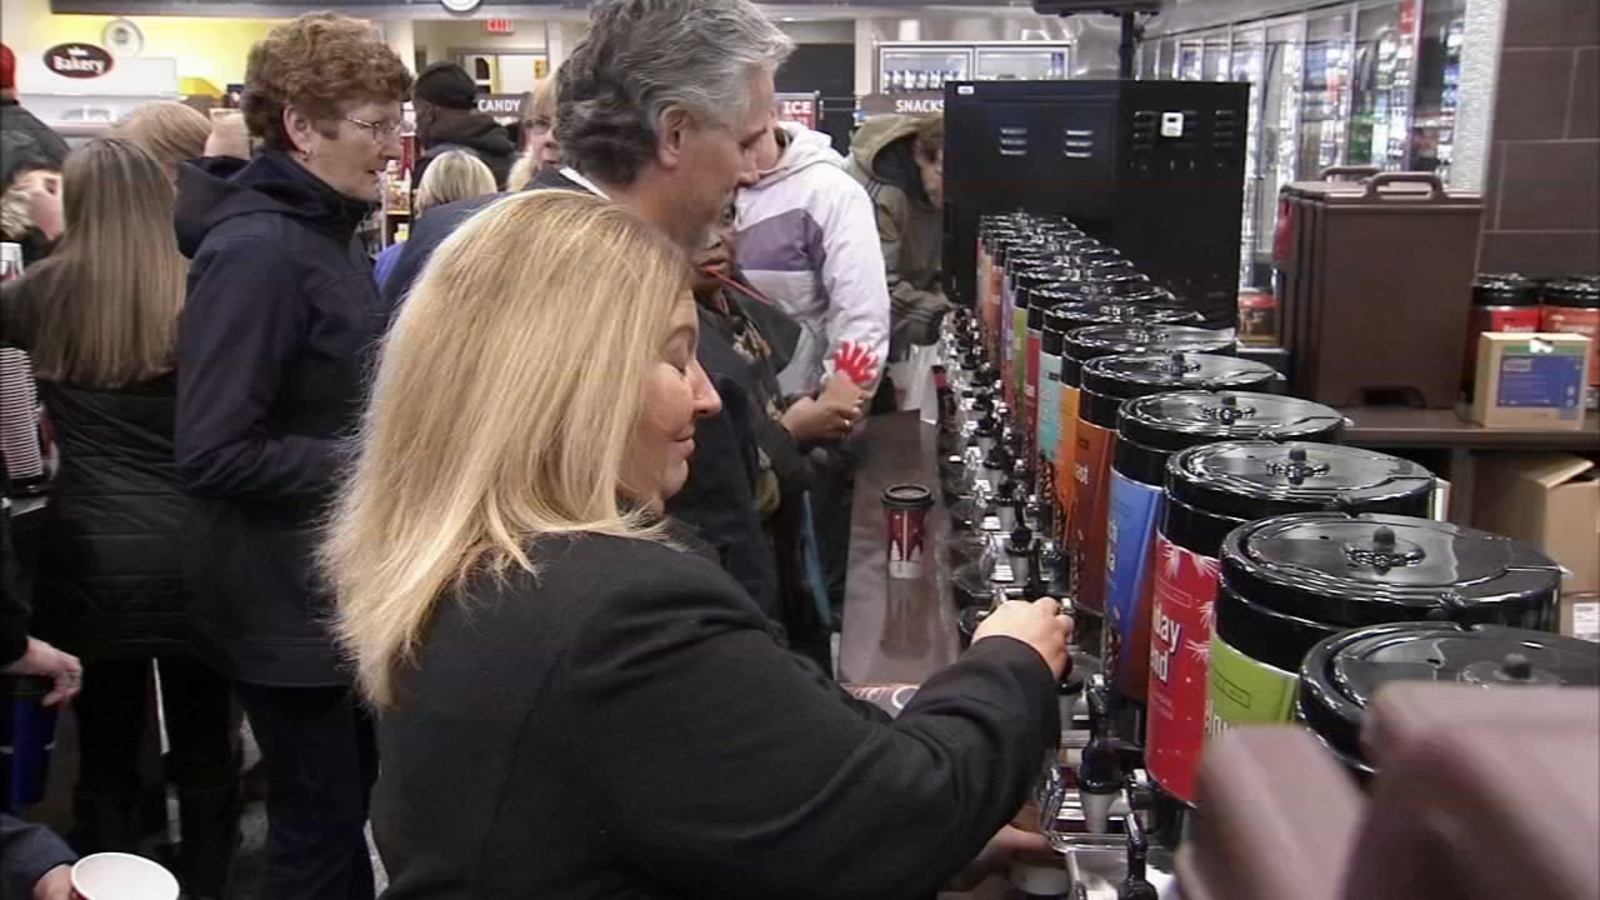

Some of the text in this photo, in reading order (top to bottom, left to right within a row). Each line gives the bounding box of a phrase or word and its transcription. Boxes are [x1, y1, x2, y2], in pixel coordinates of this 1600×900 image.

[53, 55, 105, 75] Bakery
[478, 99, 521, 112] CANDY
[783, 100, 811, 114] ICE
[895, 99, 944, 113] SNACKS
